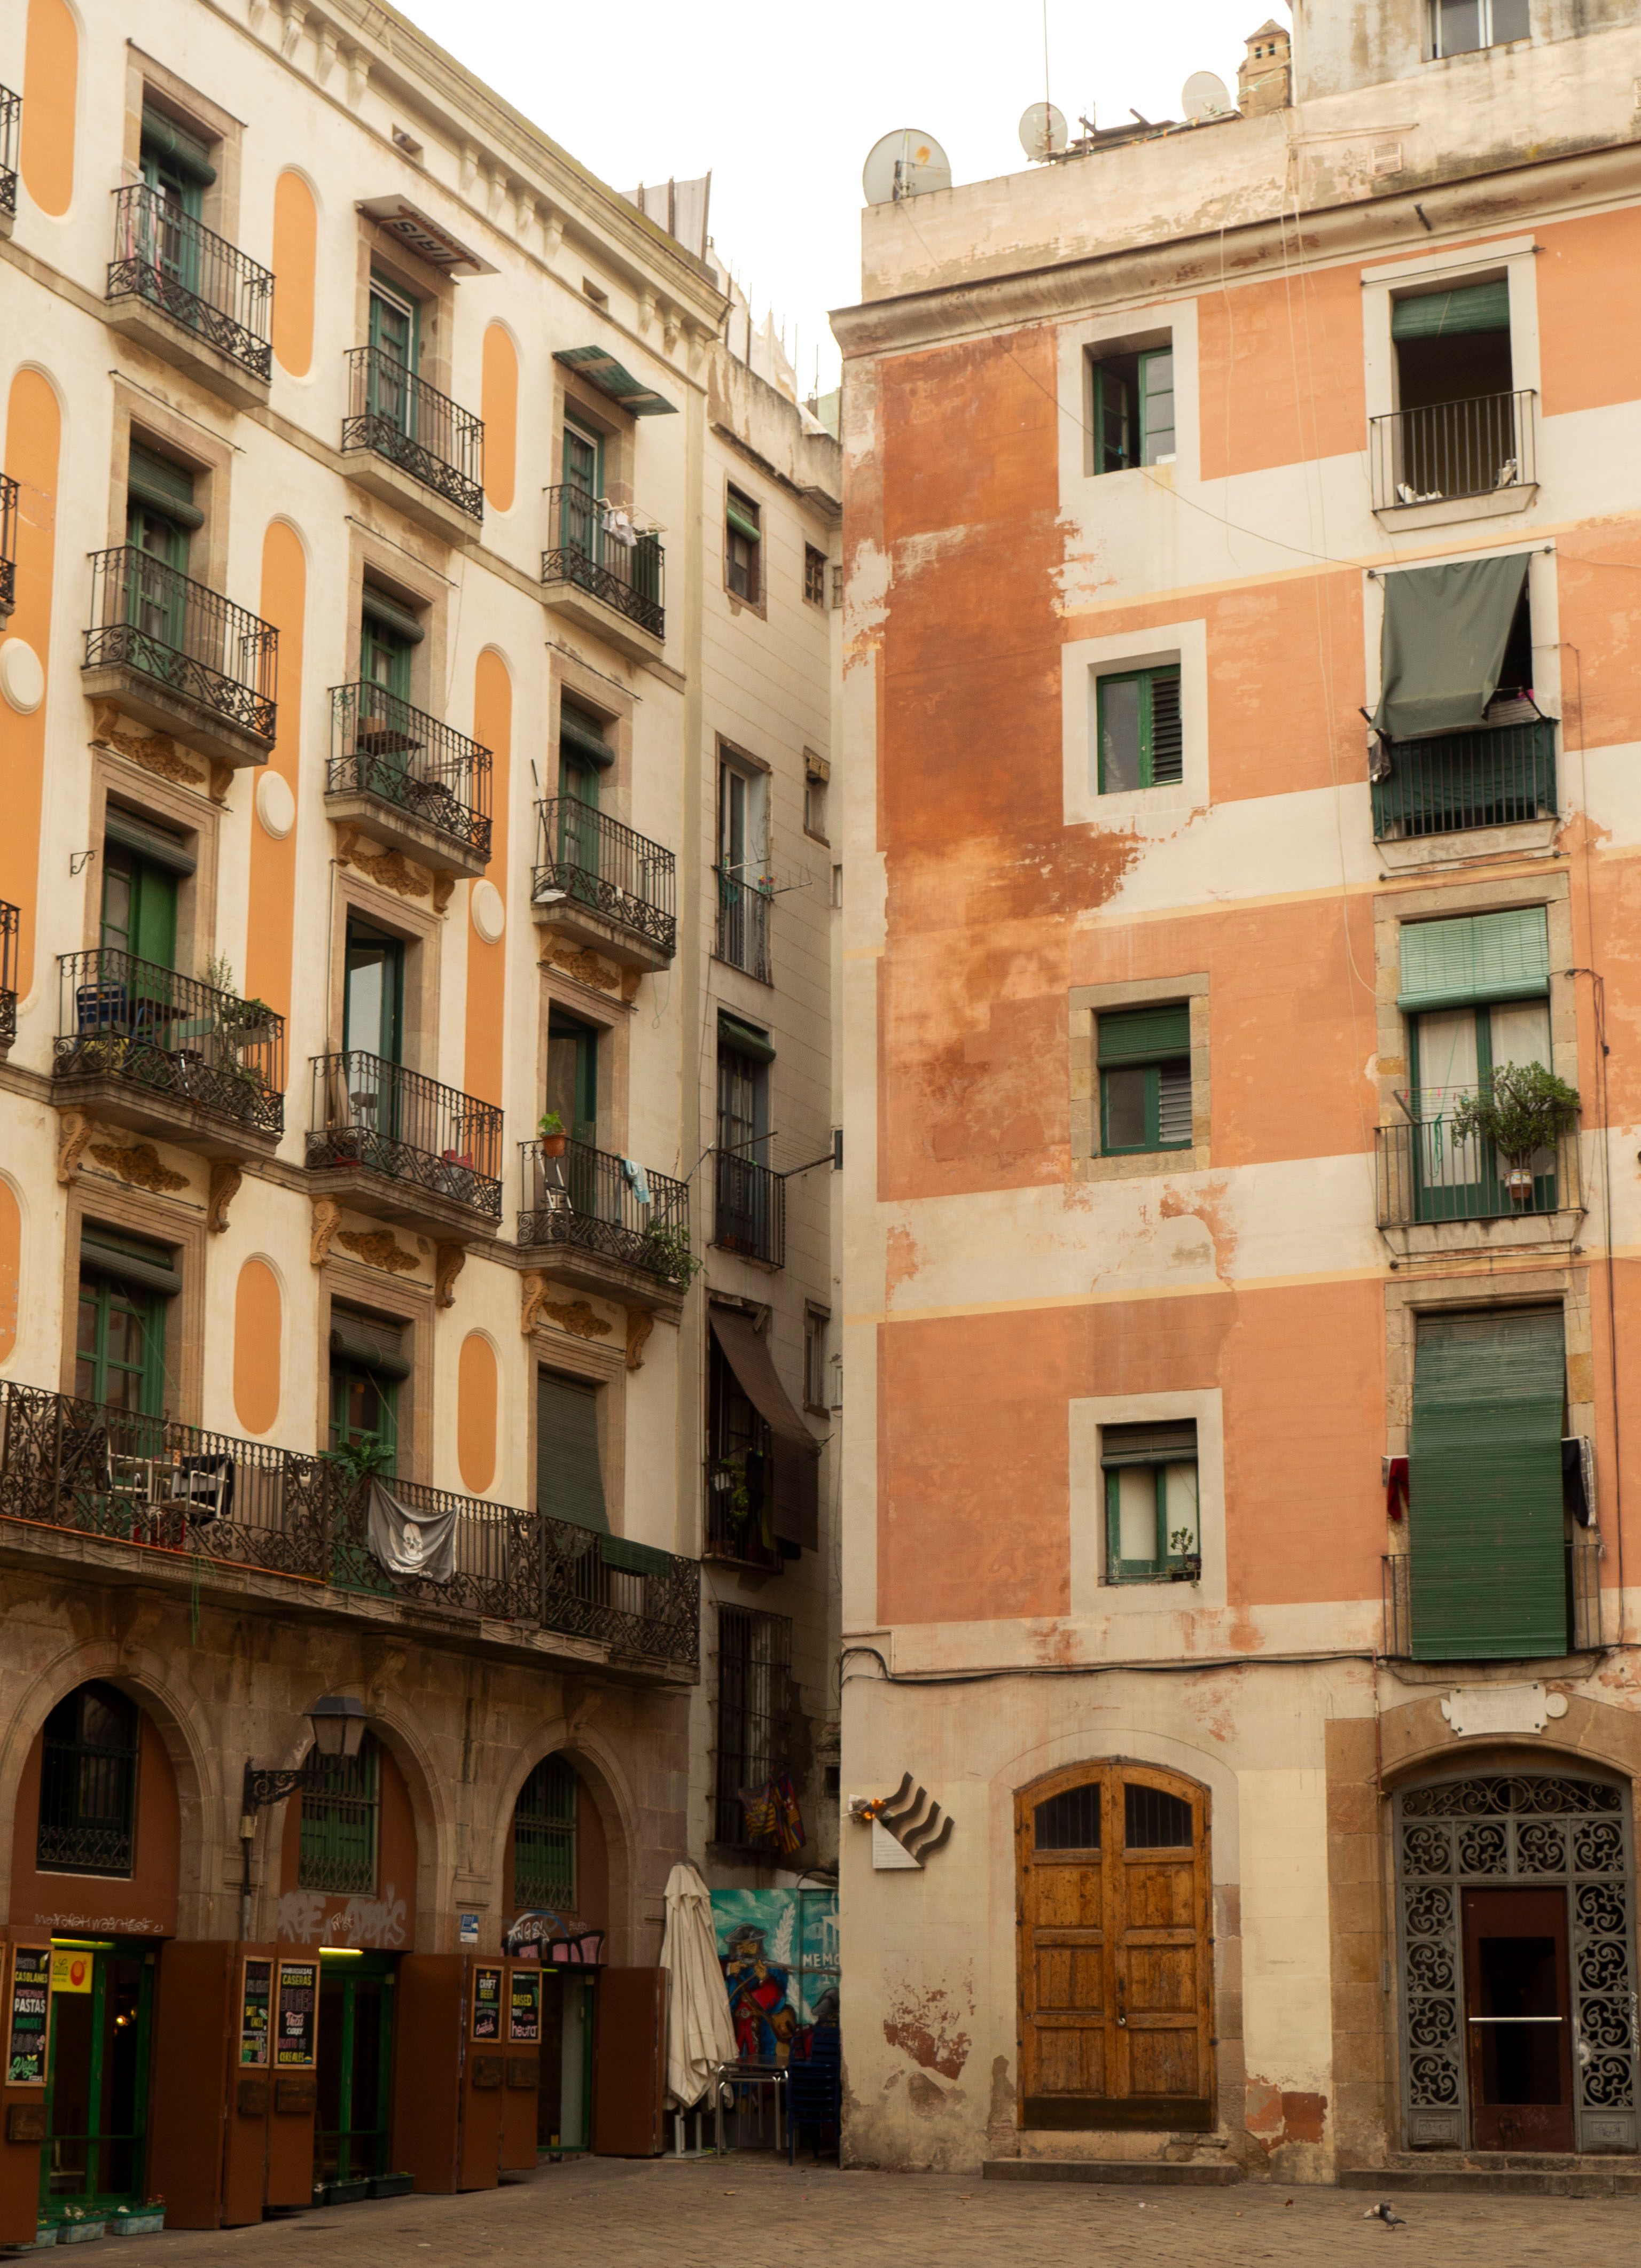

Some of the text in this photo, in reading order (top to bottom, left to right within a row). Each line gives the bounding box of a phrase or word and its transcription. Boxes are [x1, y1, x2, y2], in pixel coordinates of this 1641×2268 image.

[282, 1975, 312, 1986] CASERAS
[14, 1998, 46, 2014] PASTAS
[512, 1993, 533, 2007] BASED
[279, 2051, 305, 2063] CEREALES
